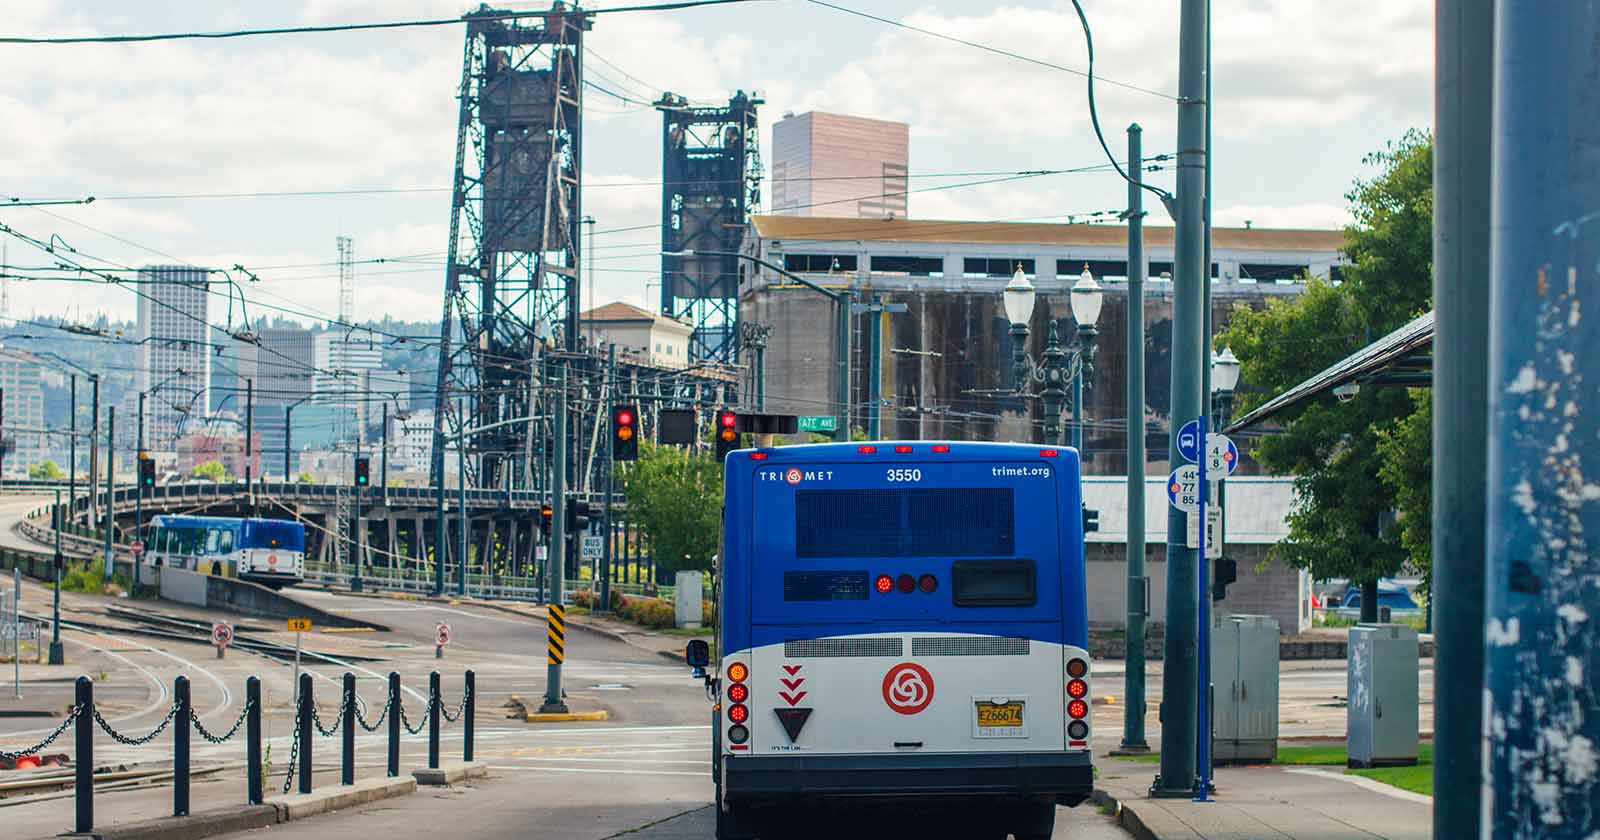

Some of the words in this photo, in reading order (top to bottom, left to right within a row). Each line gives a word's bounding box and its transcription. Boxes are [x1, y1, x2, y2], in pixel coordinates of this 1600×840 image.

[821, 418, 833, 428] AVE
[1213, 446, 1220, 455] 4
[1213, 458, 1220, 468] 8
[886, 469, 921, 482] 3550
[992, 466, 1050, 478] trimet.org
[1182, 471, 1195, 480] 44
[1182, 482, 1195, 493] 77
[1182, 495, 1195, 505] 85
[584, 538, 601, 547] BUS
[583, 548, 602, 556] ONLY
